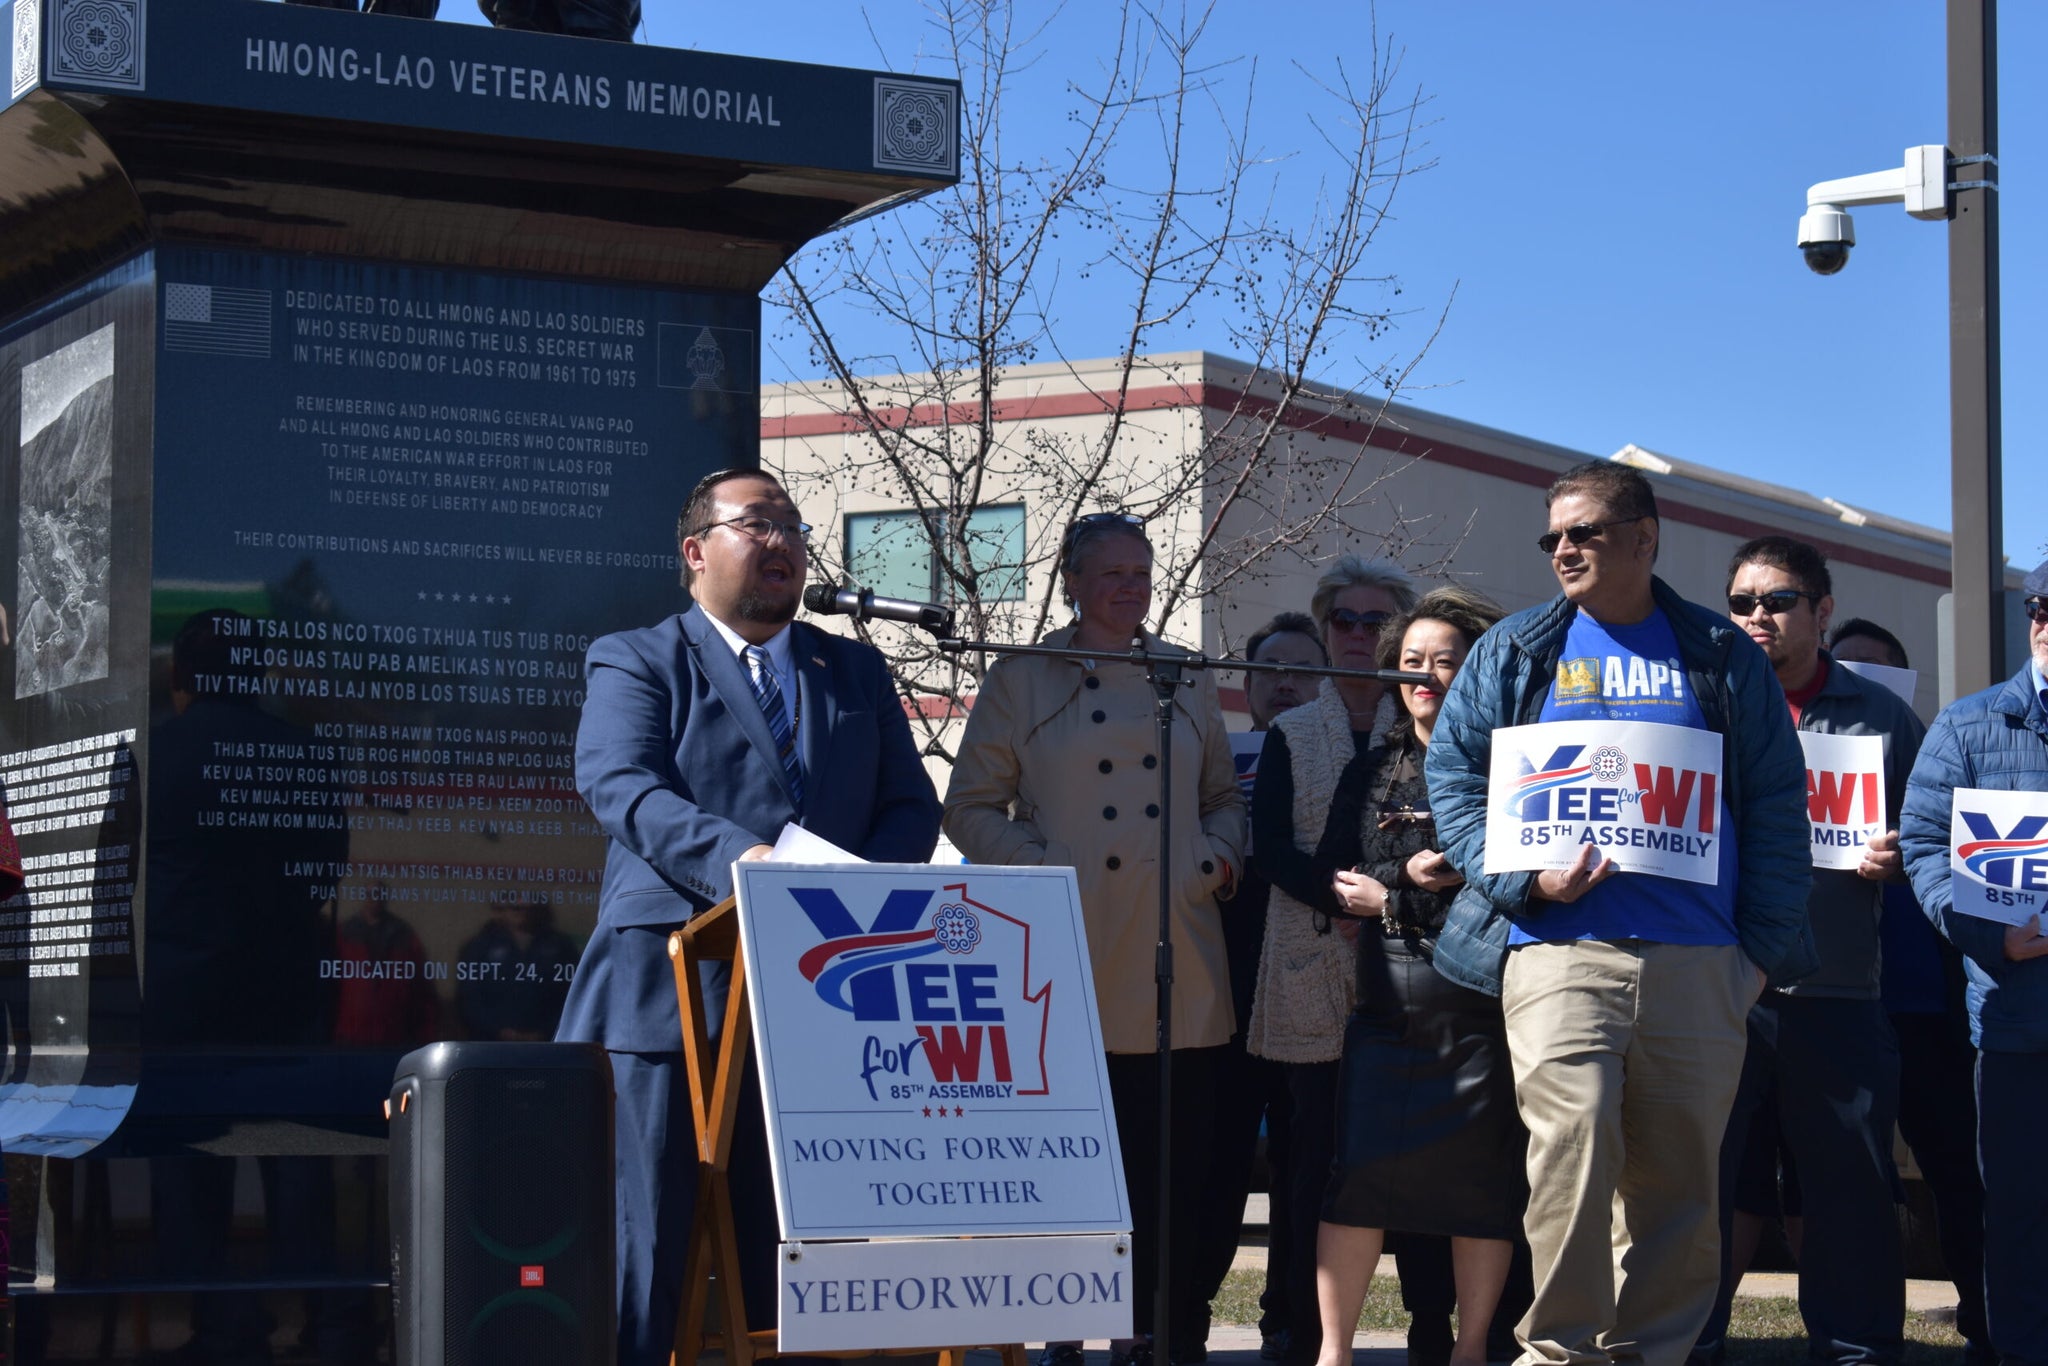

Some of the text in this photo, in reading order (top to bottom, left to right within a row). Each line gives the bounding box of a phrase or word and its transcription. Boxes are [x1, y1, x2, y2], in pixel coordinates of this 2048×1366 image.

[246, 37, 782, 127] HMONG-LAO VETERANS MEMORIAL
[285, 290, 646, 337] DEDICATED TO ALL HMONG AND LAO SOLDIERS
[296, 317, 635, 362] WHO SERVED DURING THE U.S. SECRET WAR
[293, 343, 637, 388] IN THE KINGDOM OF LAOS FROM 1961 TO 1975
[296, 396, 634, 433] REMEMBERING AND HONORING GENERAL VANG PAO
[278, 418, 649, 457] AND ALL HMONG AND LAO SOLDIERS WHO CONTRIBUTED
[320, 443, 613, 477] TO THE AMERICAN WAR EFFORT IN LAOS FOR
[327, 466, 367, 484] THEIR
[501, 476, 530, 493] AND
[531, 478, 610, 498] PATRIOTISM
[329, 489, 603, 519] IN DEFENSE OF LIBERTY AND DEMOCRACY
[233, 531, 274, 548] THEIR
[276, 533, 389, 555] CONTRIBUTIONS
[391, 539, 420, 556] AND
[422, 541, 501, 561] SACRIFICES
[503, 546, 535, 563] WILL
[538, 548, 583, 565] NEVER
[584, 550, 603, 566] BE
[212, 617, 588, 653] TSIM TSA LOS NCO TXOG TXHUA TUS TUB ROG
[230, 646, 577, 680] NPLOG UAS TAU PAB AMELIKAS NYOB RAU
[194, 674, 583, 708] TIV THAIV NYAB LAJ NYOB LOS TSUAS TEB XYO
[314, 722, 574, 747] NCO THIAB HAWM TXOG NAIS PHOO VAJ
[213, 741, 571, 769] THIAB TXHUA TUS TUB ROG HMOOB THIAB NPLOG UAS
[203, 764, 546, 791] KEV UA TSOV ROG NYOB LOS TSUAS TEB RAU LAWV
[1516, 745, 1717, 835] YEE for WI
[220, 788, 248, 804] KEV
[251, 789, 289, 806] MUAJ
[292, 790, 328, 807] PEEV
[1806, 768, 1879, 826] WI
[197, 811, 344, 831] LUB CHAW KOM MUAJ
[1520, 824, 1713, 858] 85TH ASSEMBLY
[1958, 809, 2048, 893] YE
[1985, 886, 2036, 907] 85TH
[787, 887, 1006, 1022] YEE
[319, 959, 574, 985] DEDICATED ON SEPT. 24, 20
[860, 1025, 1014, 1102] for WI
[890, 1084, 1013, 1099] 85TH ASSEMBLY
[793, 1135, 1101, 1163] MOVING FORWARD
[869, 1180, 1043, 1207] TOGETHER
[787, 1270, 1124, 1316] YEEFORWI.COM
